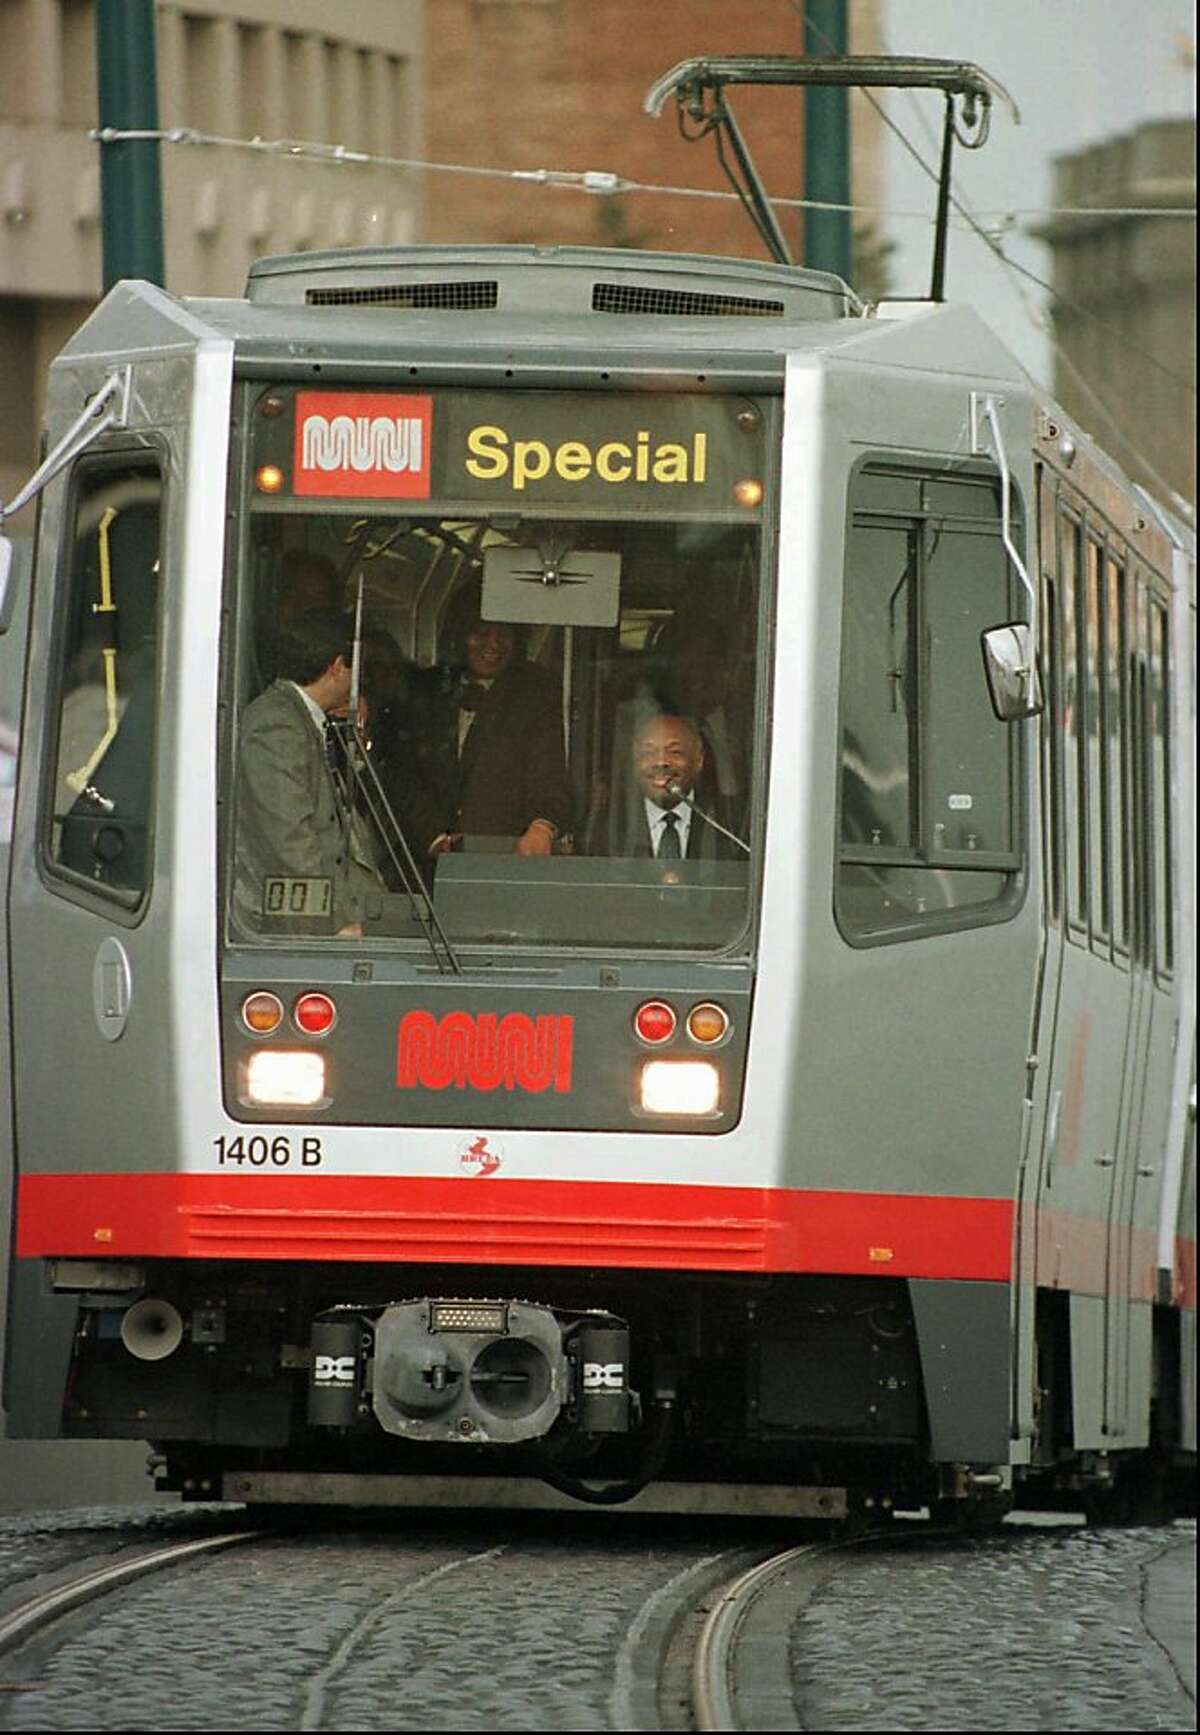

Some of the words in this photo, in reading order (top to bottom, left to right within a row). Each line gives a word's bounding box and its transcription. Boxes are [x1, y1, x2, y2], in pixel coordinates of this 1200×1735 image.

[466, 426, 706, 489] Special
[267, 882, 330, 911] 001
[213, 1136, 290, 1165] 1406
[301, 1138, 322, 1166] B
